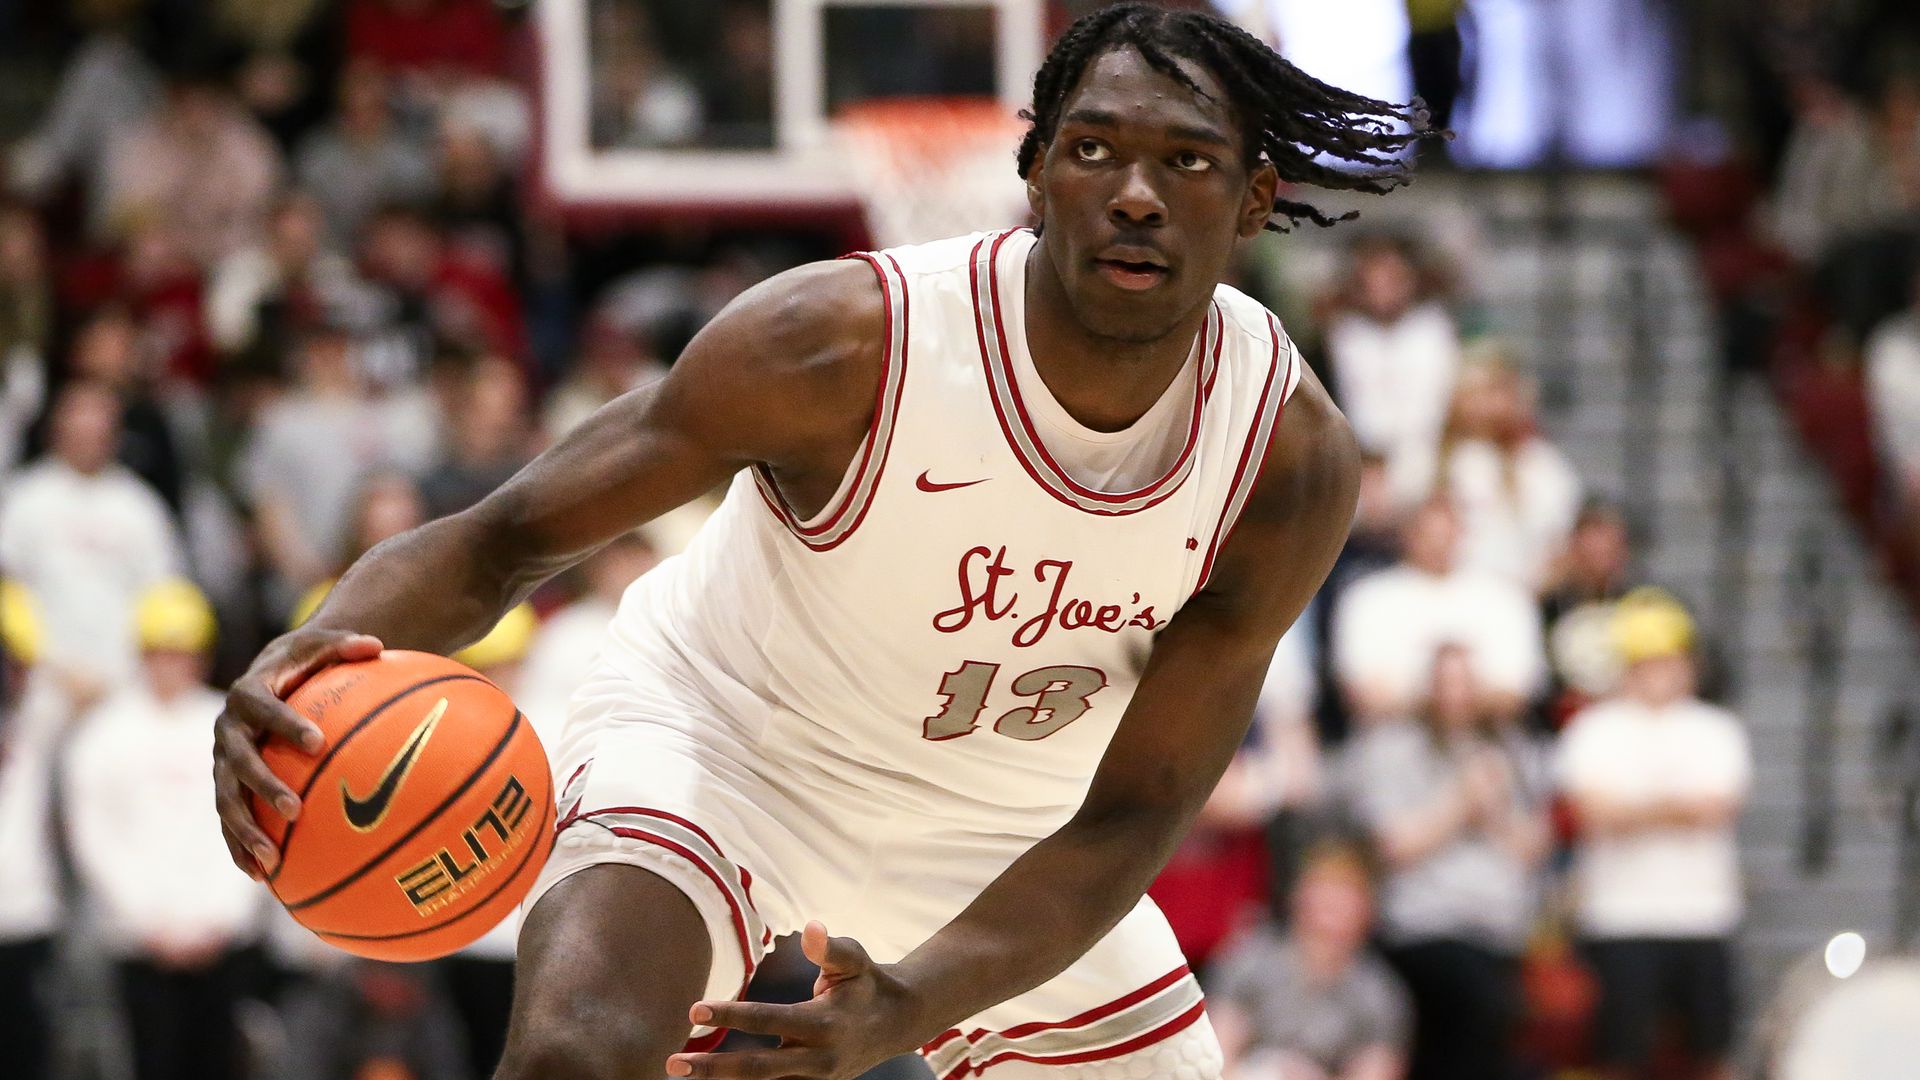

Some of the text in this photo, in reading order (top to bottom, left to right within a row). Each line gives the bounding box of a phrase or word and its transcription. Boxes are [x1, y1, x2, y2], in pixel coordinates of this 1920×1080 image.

[931, 544, 1167, 648] St. Joe's
[921, 659, 1110, 741] 13
[393, 774, 534, 907] ELITE
